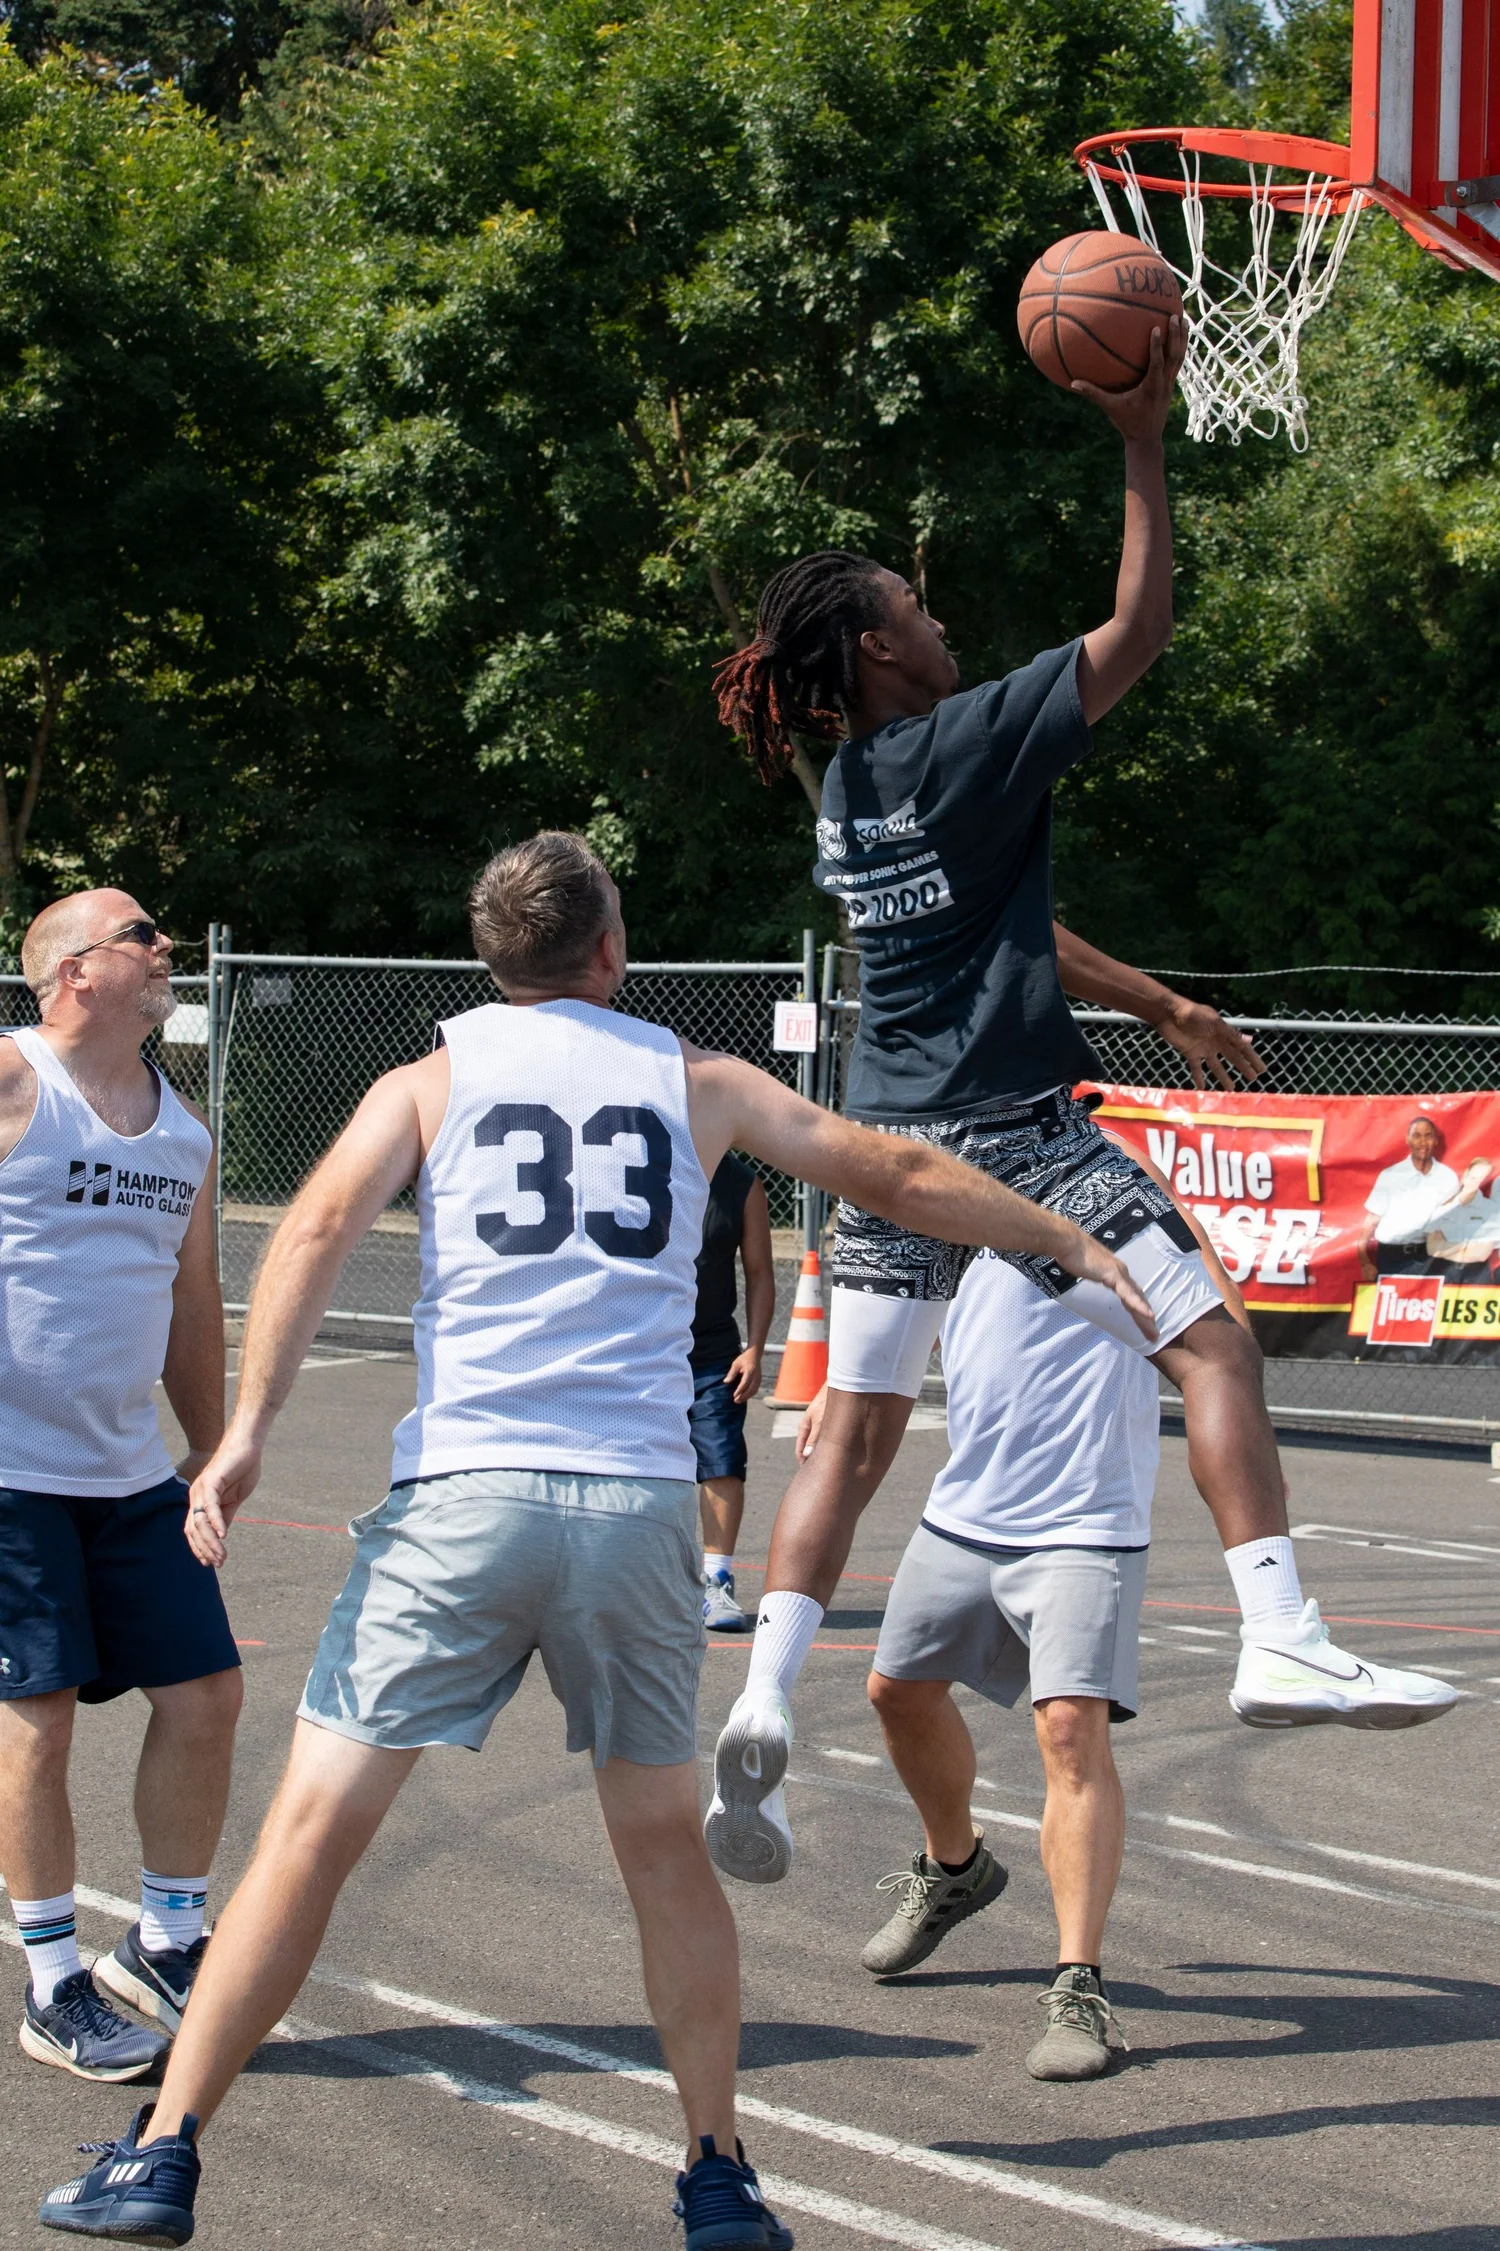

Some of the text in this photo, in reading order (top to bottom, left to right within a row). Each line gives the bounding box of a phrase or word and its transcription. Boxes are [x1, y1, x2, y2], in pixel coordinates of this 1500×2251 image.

[870, 864, 898, 880] SONIC
[898, 850, 939, 872] GAMES
[871, 880, 941, 923] 1000
[785, 1018, 812, 1042] EXIT
[1145, 1128, 1273, 1200] Value
[117, 1169, 197, 1201] HAMPTON
[474, 1103, 674, 1259] 33
[116, 1191, 191, 1217] AUTO GLASS
[1377, 1285, 1436, 1326] Tires
[1441, 1299, 1478, 1324] LES
